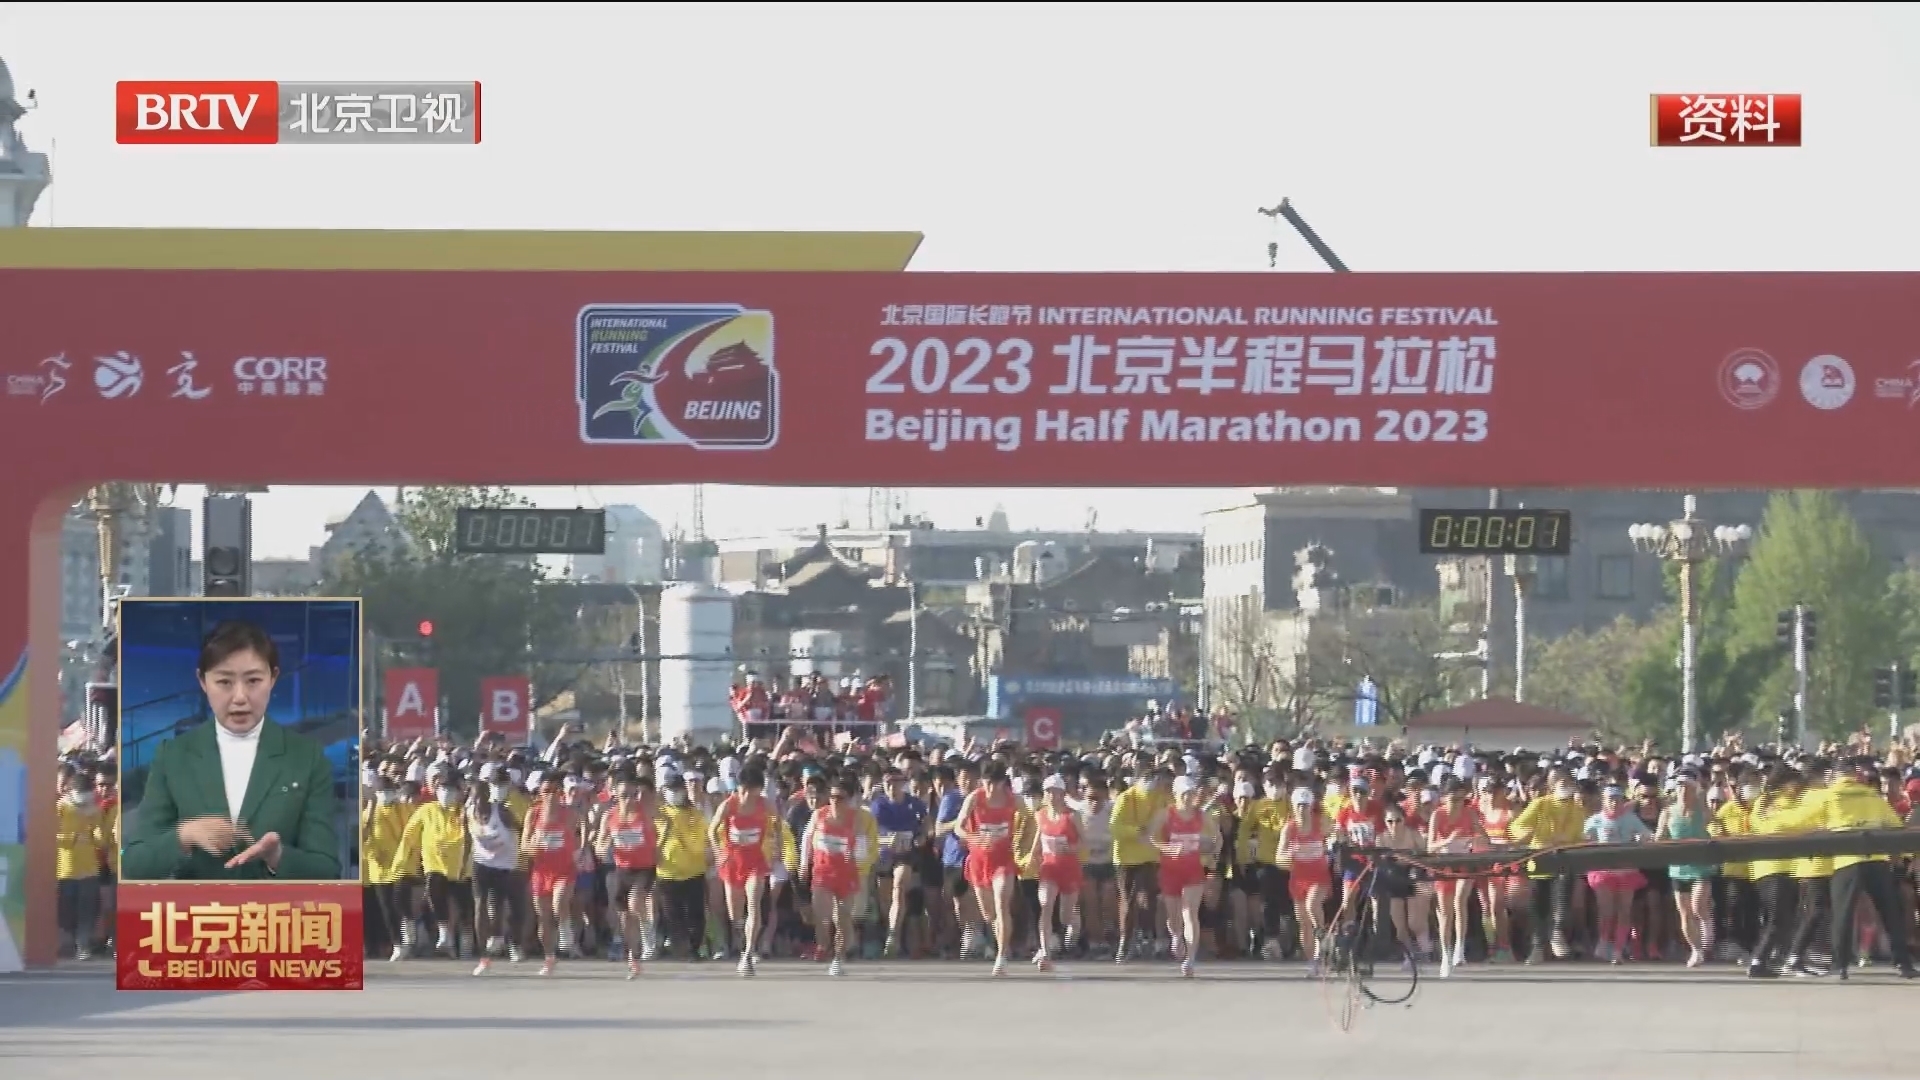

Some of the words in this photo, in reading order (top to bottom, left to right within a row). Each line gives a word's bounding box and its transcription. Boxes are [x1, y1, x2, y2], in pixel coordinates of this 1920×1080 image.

[590, 318, 667, 329] INTERNATIONAL
[880, 304, 1032, 326] 北京国际长跑节
[1039, 306, 1248, 326] INTERNATIONAL
[1254, 306, 1374, 326] RUNNING
[1381, 306, 1498, 326] FESTIVAL
[590, 342, 638, 354] FESTIVAL
[233, 357, 328, 380] CORR
[865, 336, 1034, 394] 2023
[1049, 334, 1497, 396] 北京半程马拉松
[684, 400, 762, 420] BEIJING
[865, 408, 1022, 451] Beijing
[1035, 408, 1130, 442] Half
[1140, 408, 1362, 442] Marathon
[1374, 409, 1489, 442] 2023
[1431, 516, 1560, 548] 0:00:01
[395, 682, 426, 717] A
[492, 690, 519, 722] B
[1033, 716, 1054, 740] C
